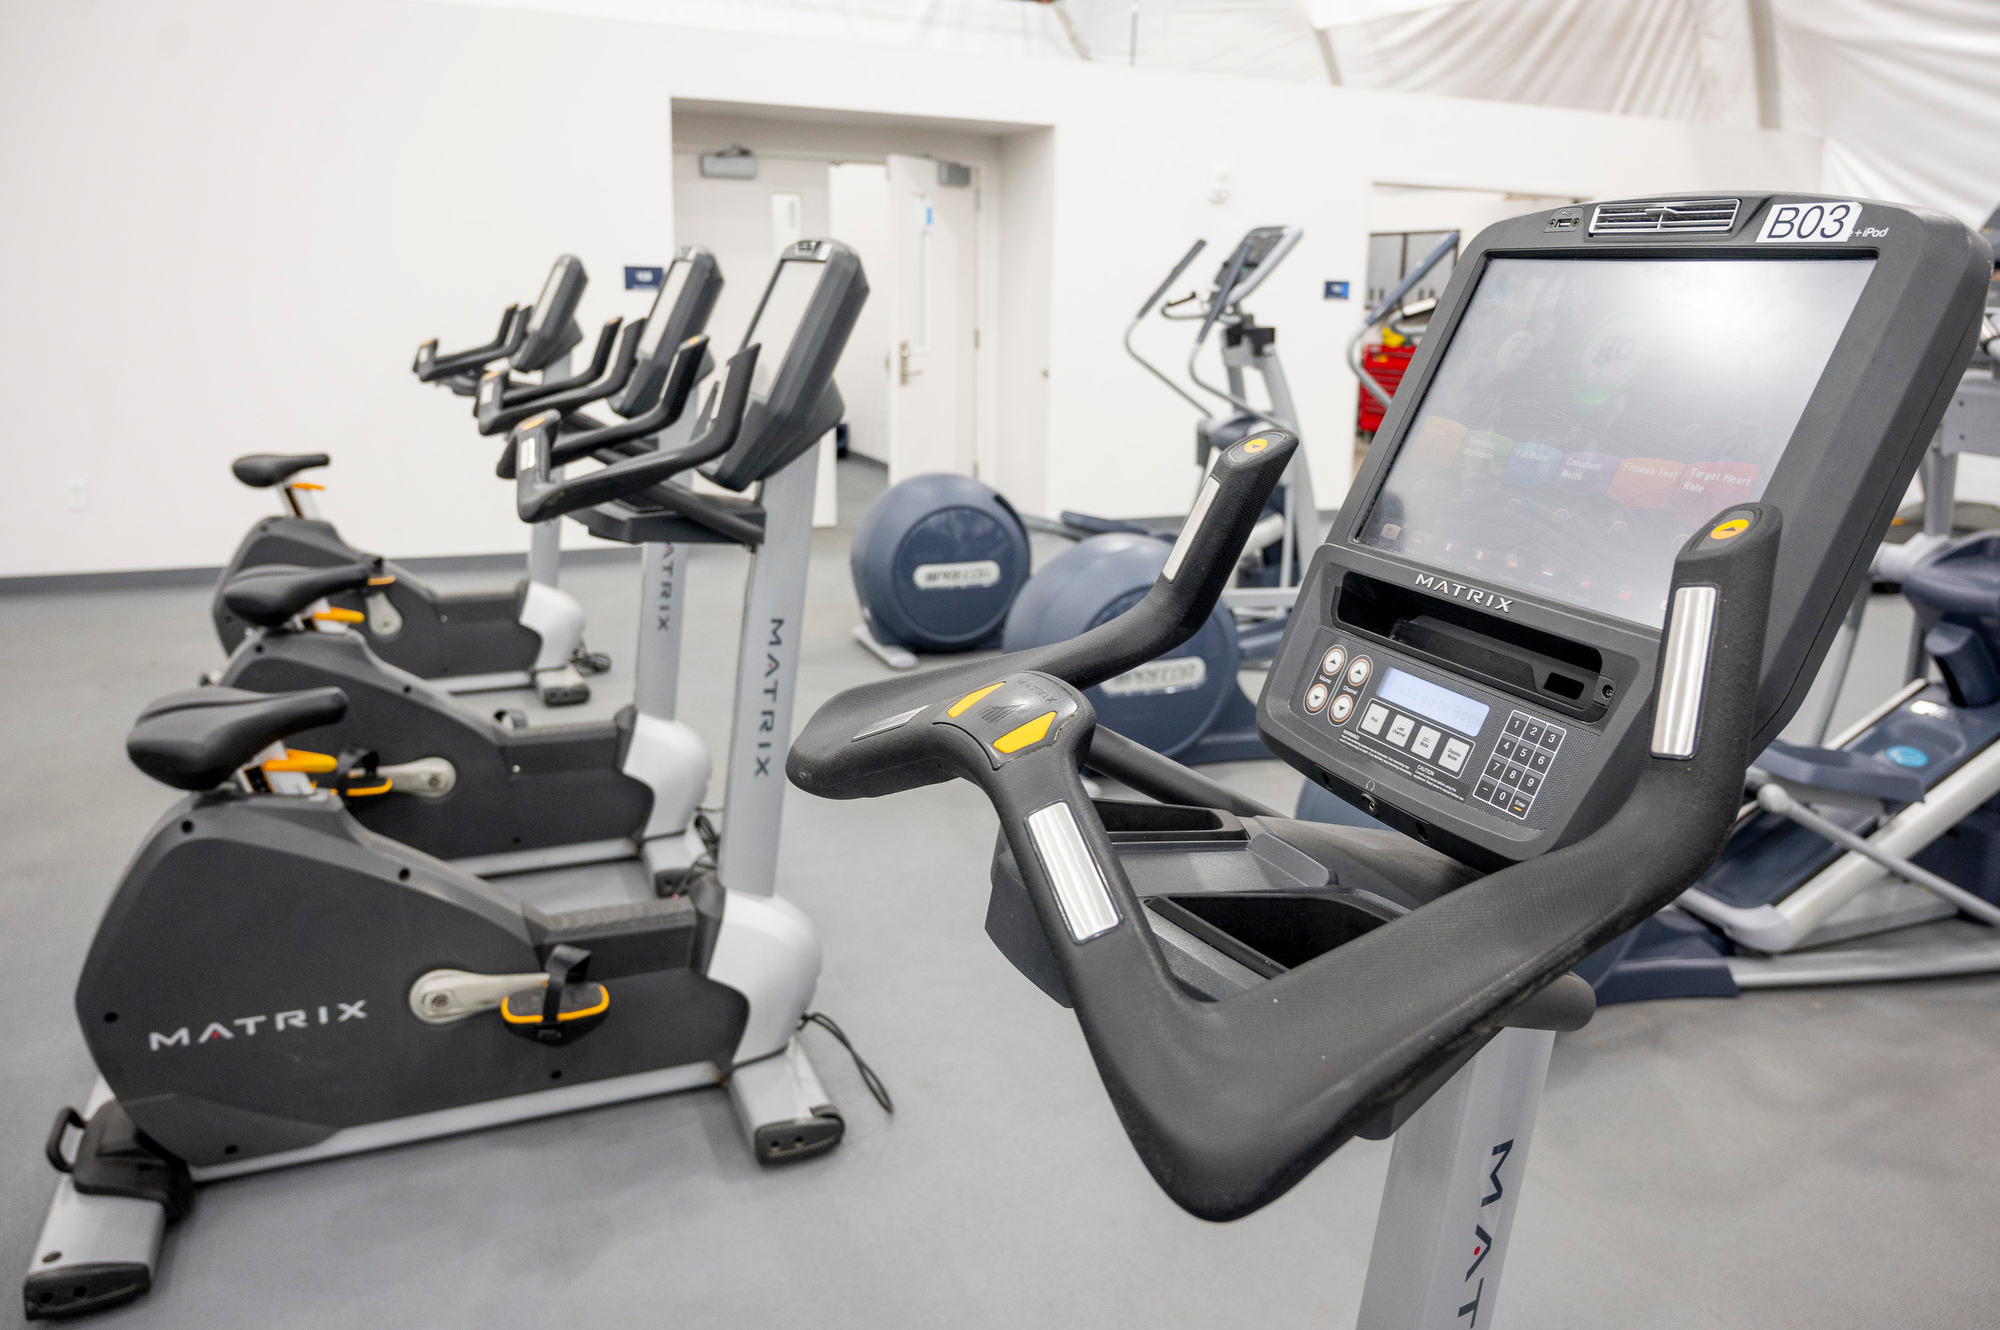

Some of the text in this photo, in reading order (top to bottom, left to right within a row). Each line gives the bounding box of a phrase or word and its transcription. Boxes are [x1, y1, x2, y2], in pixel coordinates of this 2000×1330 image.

[1766, 204, 1850, 239] B03
[1592, 335, 1637, 367] go
[1468, 436, 1497, 450] Training
[1463, 448, 1495, 461] Workouts
[1515, 449, 1549, 462] Fat Burn
[1566, 457, 1601, 471] Constant
[1560, 469, 1583, 481] Watts
[1622, 461, 1679, 480] Fitness Test
[1689, 467, 1751, 487] Target Heart
[1682, 481, 1705, 493] Rate
[656, 542, 676, 632] ATRIX
[1414, 573, 1514, 613] MATRIX
[755, 617, 785, 777] MATRIX
[1016, 678, 1058, 703] MATRIX
[1342, 685, 1359, 696] Channel
[1386, 678, 1418, 701] Press
[1420, 694, 1436, 707] go
[1439, 700, 1450, 713] to
[1513, 720, 1556, 743] 1 2 3
[1503, 741, 1546, 765] 4 5 6
[1416, 764, 1436, 777] CAUTION
[1492, 762, 1535, 787] 7 8 9
[1499, 791, 1507, 801] 0
[149, 999, 368, 1051] MATRIX
